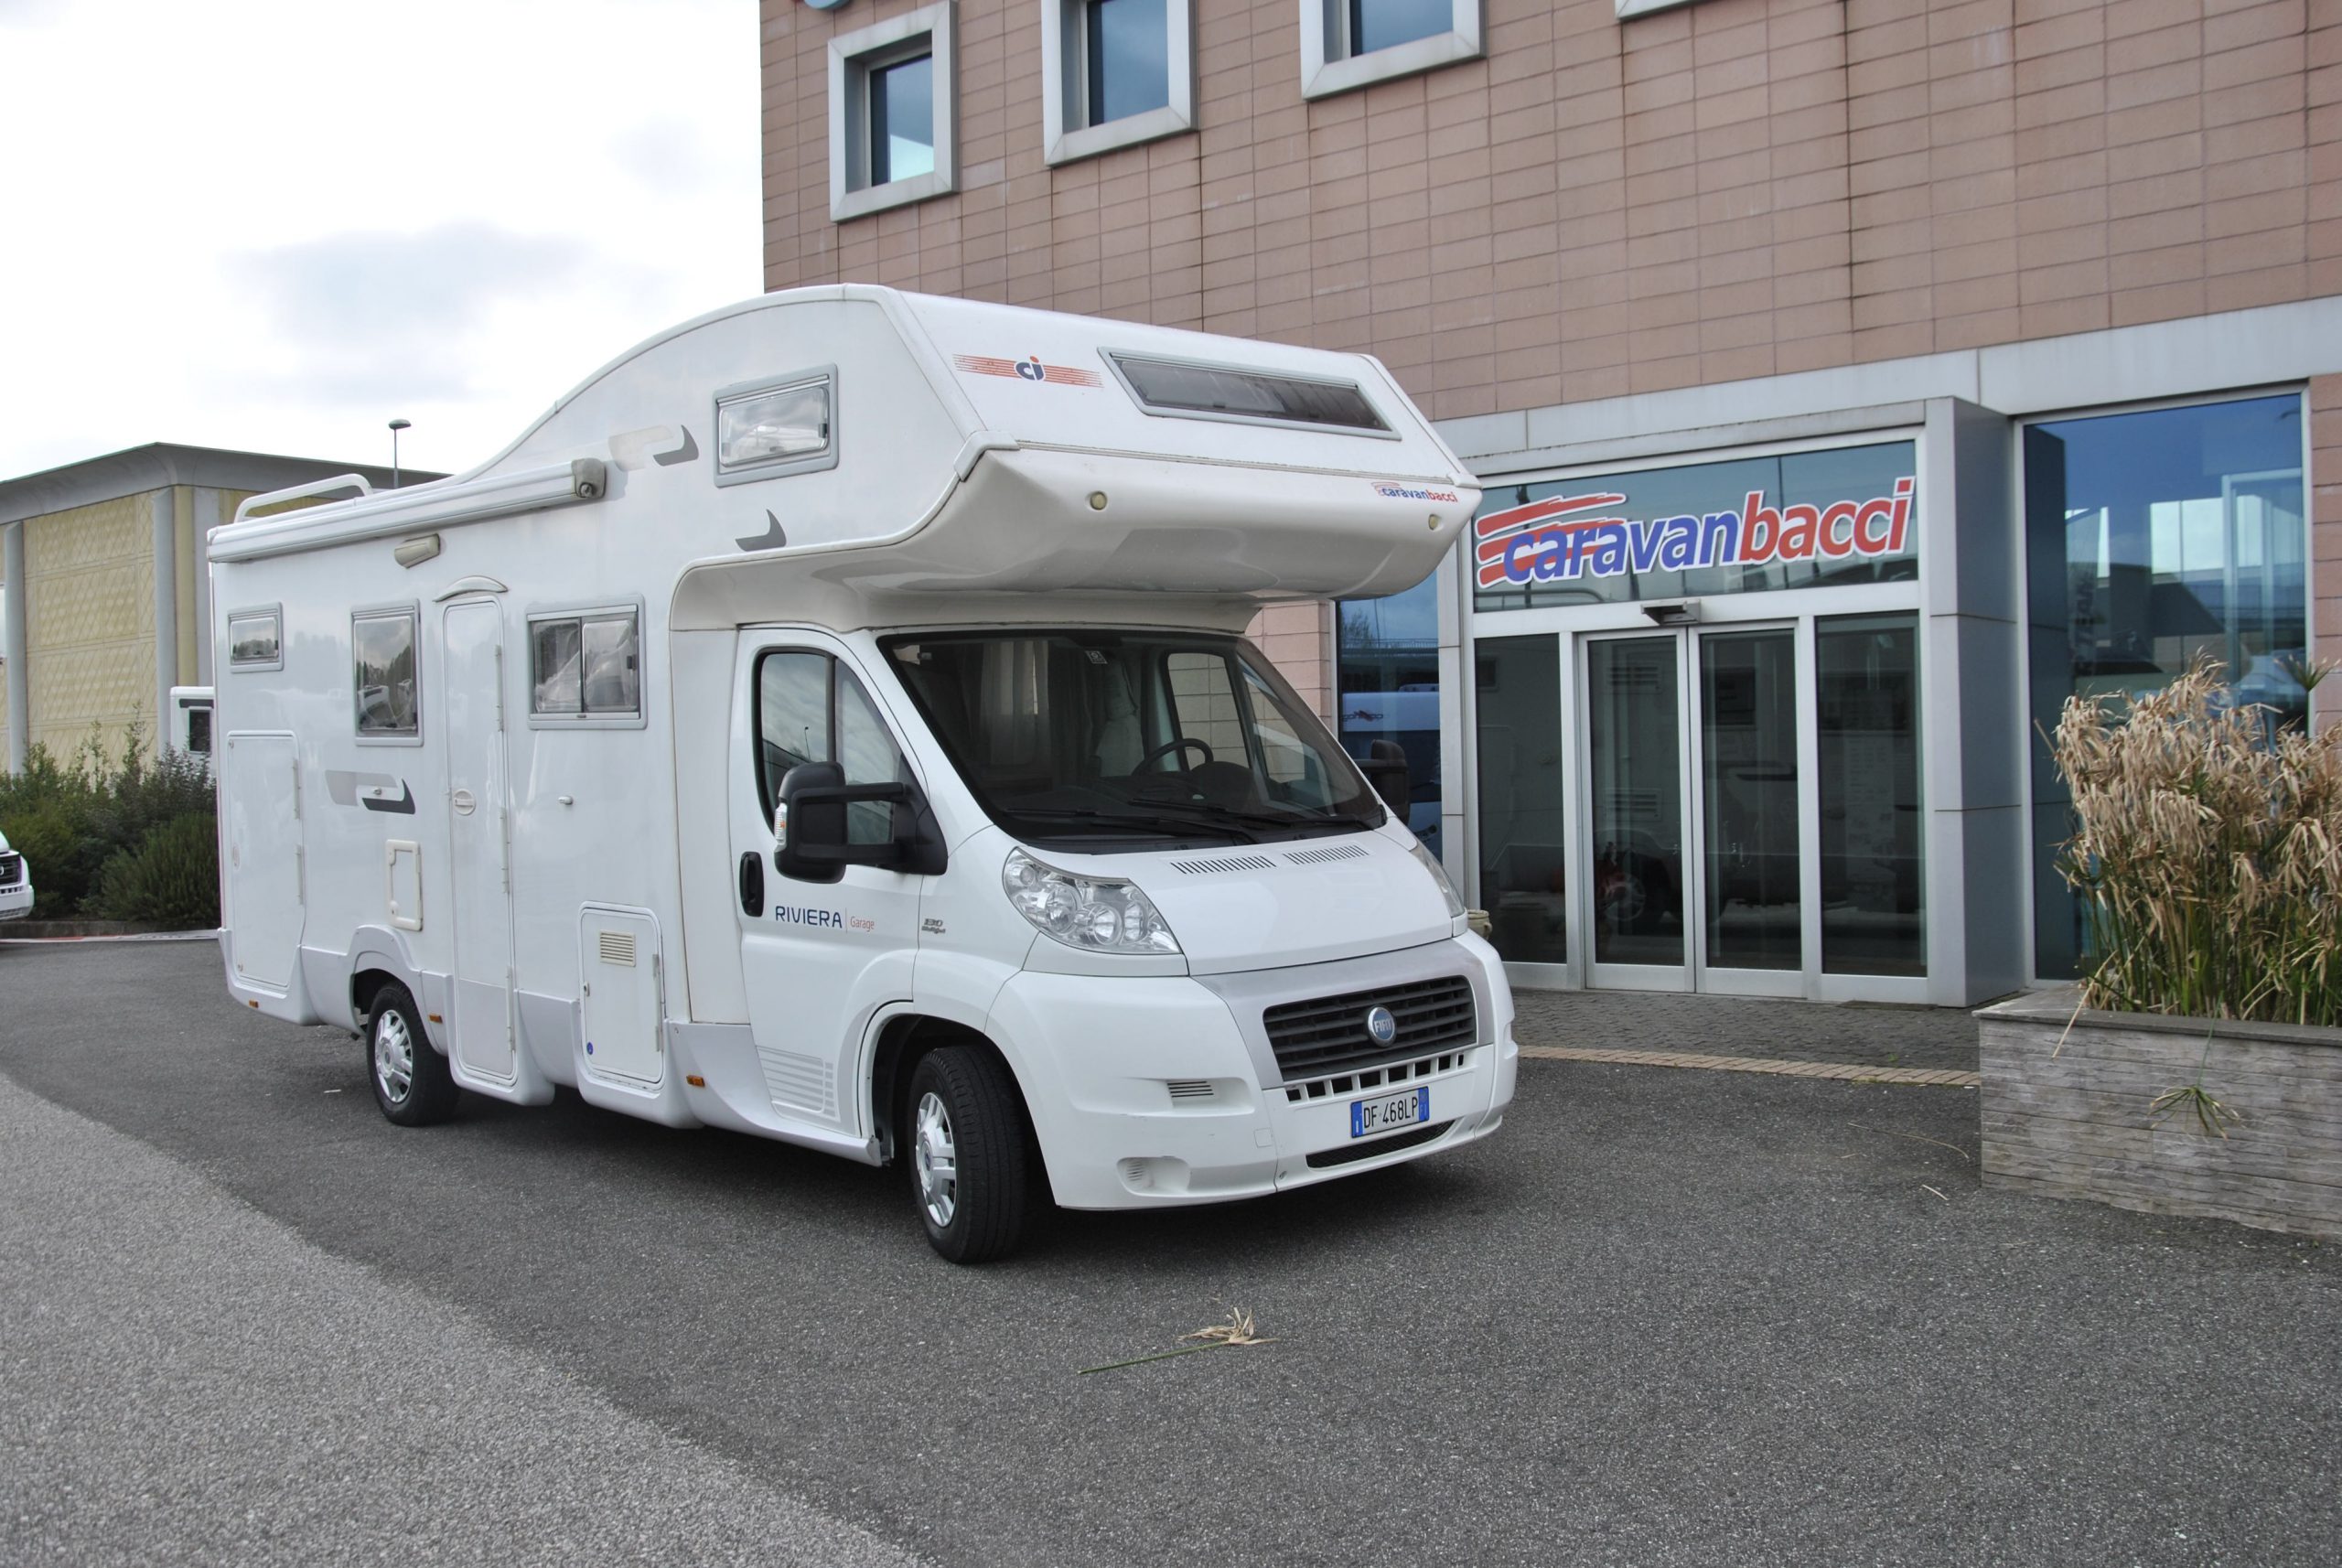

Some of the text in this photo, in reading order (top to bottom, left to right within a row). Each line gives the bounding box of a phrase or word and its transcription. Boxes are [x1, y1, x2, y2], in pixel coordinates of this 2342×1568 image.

[1381, 487, 1458, 503] caravanbacci
[1503, 476, 1915, 585] caravanbacci
[775, 905, 875, 932] RIVIERA Garage
[1374, 1018, 1392, 1033] FIAT
[1363, 1105, 1378, 1129] DF
[1382, 1097, 1418, 1124] 468LP
